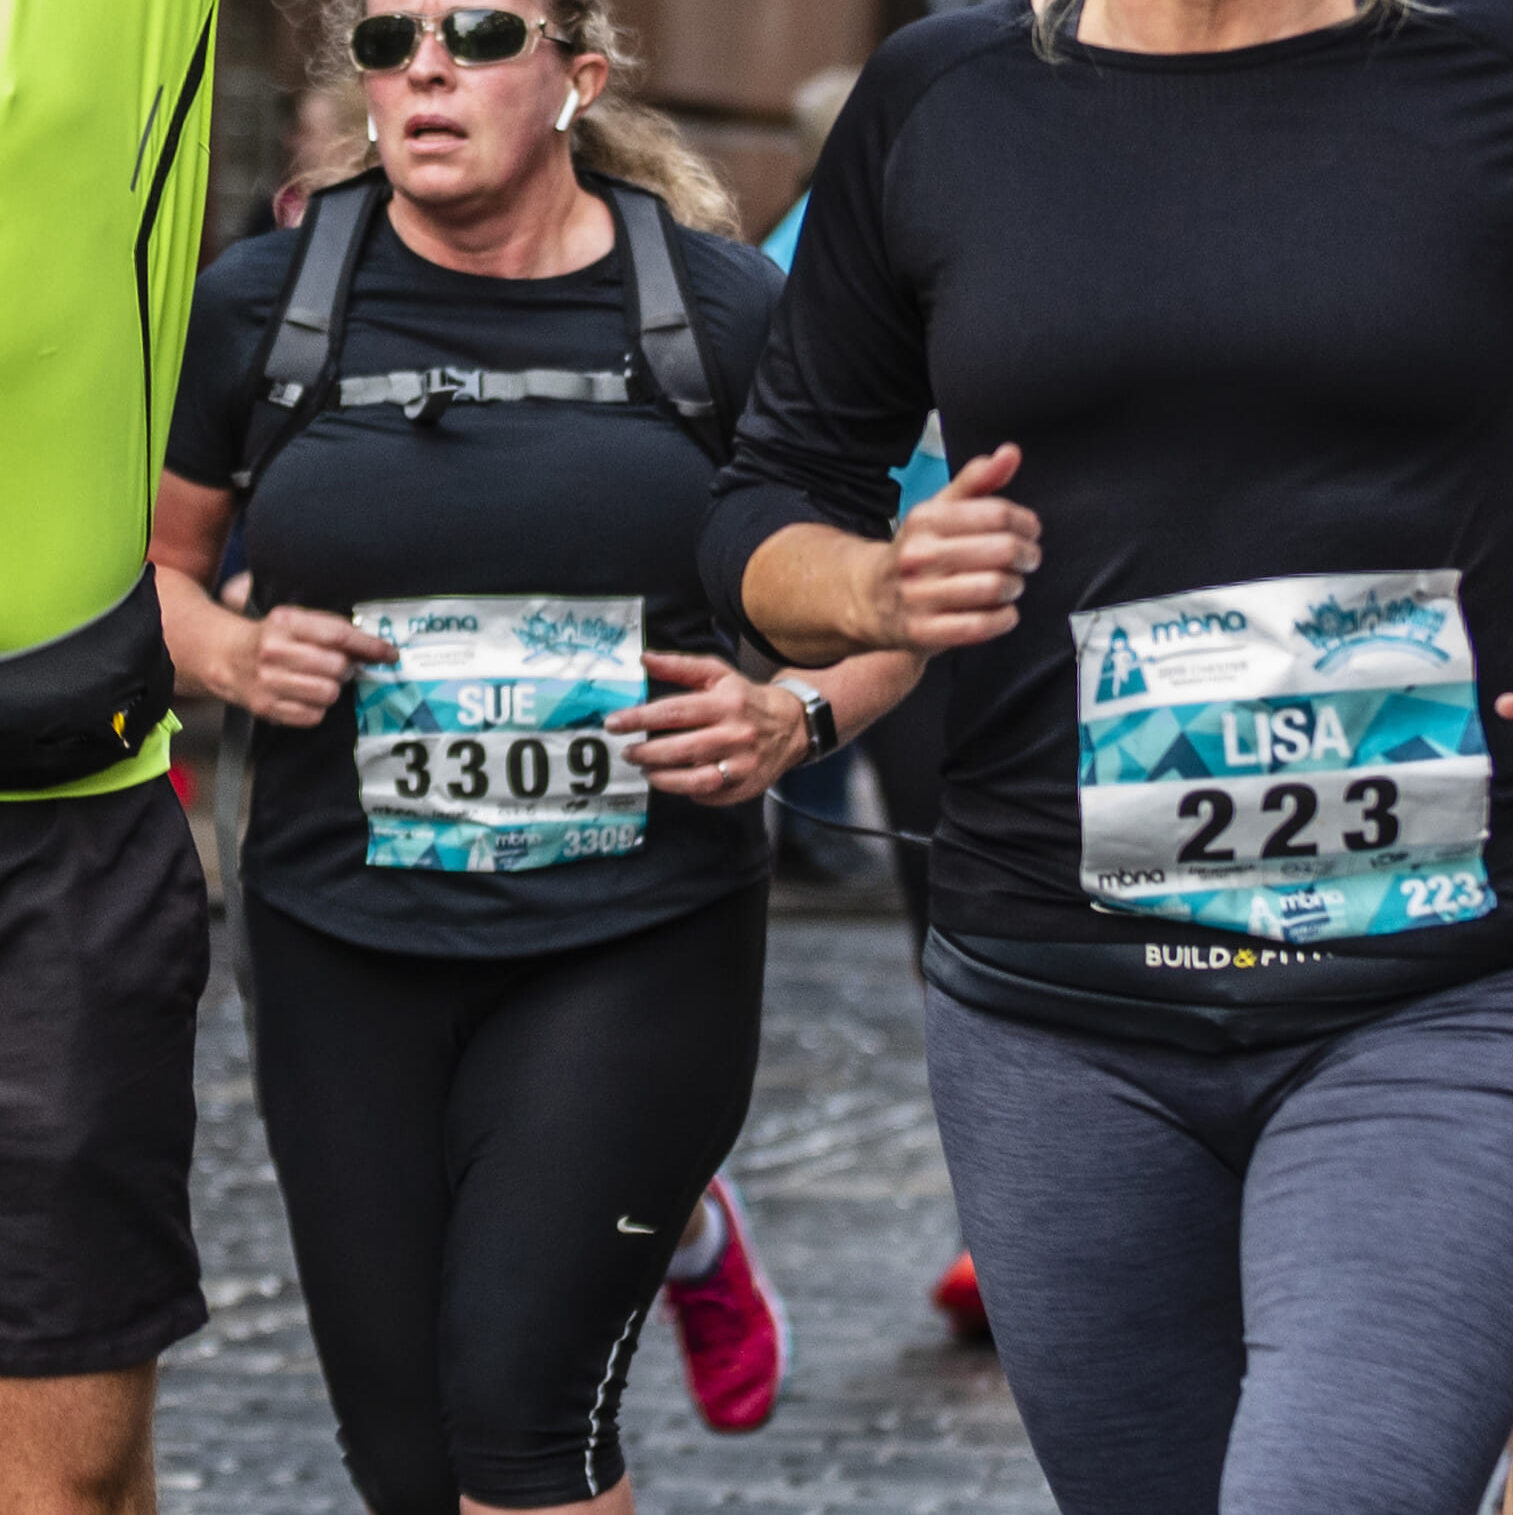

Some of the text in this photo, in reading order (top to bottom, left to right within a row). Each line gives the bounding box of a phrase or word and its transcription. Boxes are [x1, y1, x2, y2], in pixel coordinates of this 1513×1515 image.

[408, 613, 478, 633] mbna
[1152, 610, 1247, 645] mbna
[456, 684, 537, 726] SUE
[1221, 706, 1352, 767] LISA
[390, 738, 611, 800] 3309
[1177, 775, 1400, 864] 223
[563, 824, 636, 858] 3309
[1098, 867, 1165, 889] mbna
[1400, 872, 1484, 917] 223
[1279, 888, 1345, 911] mbna
